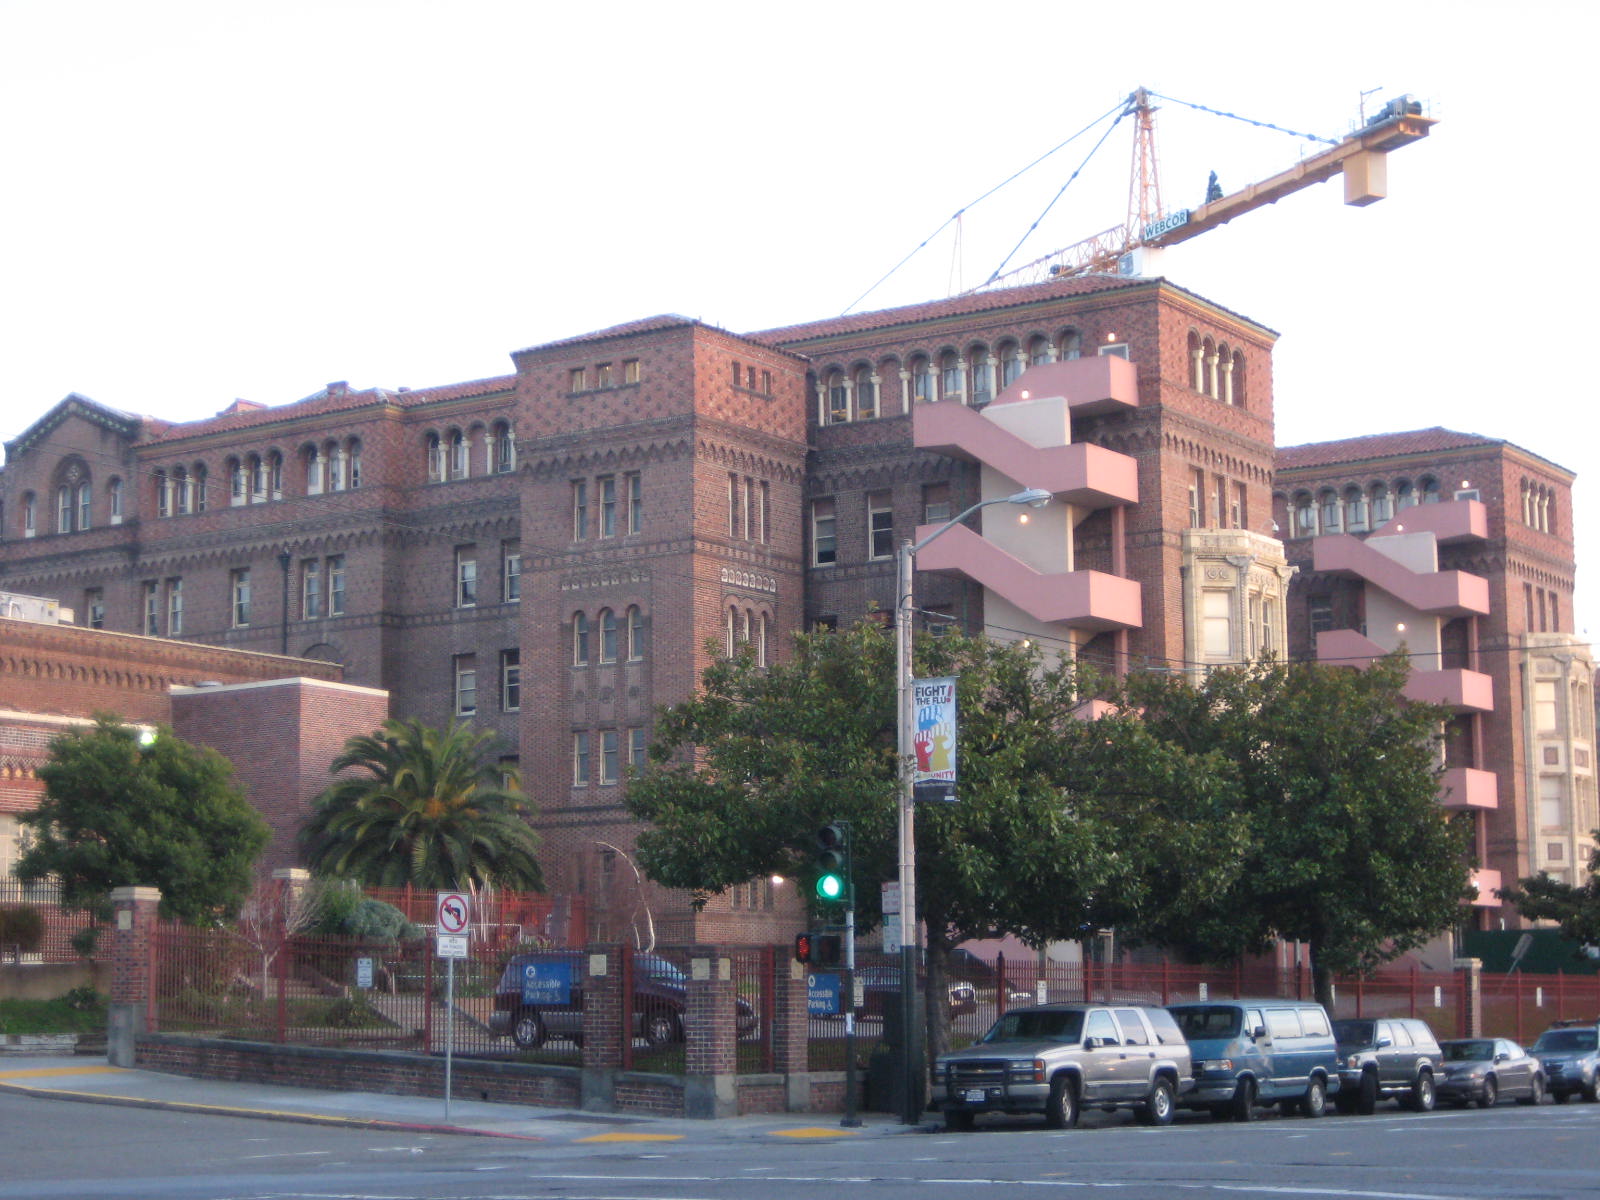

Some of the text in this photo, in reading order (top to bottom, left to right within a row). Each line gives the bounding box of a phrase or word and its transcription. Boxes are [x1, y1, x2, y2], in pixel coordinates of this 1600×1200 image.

[1145, 211, 1186, 238] WEBCOR
[915, 685, 946, 697] FIGHT
[916, 697, 931, 705] THE
